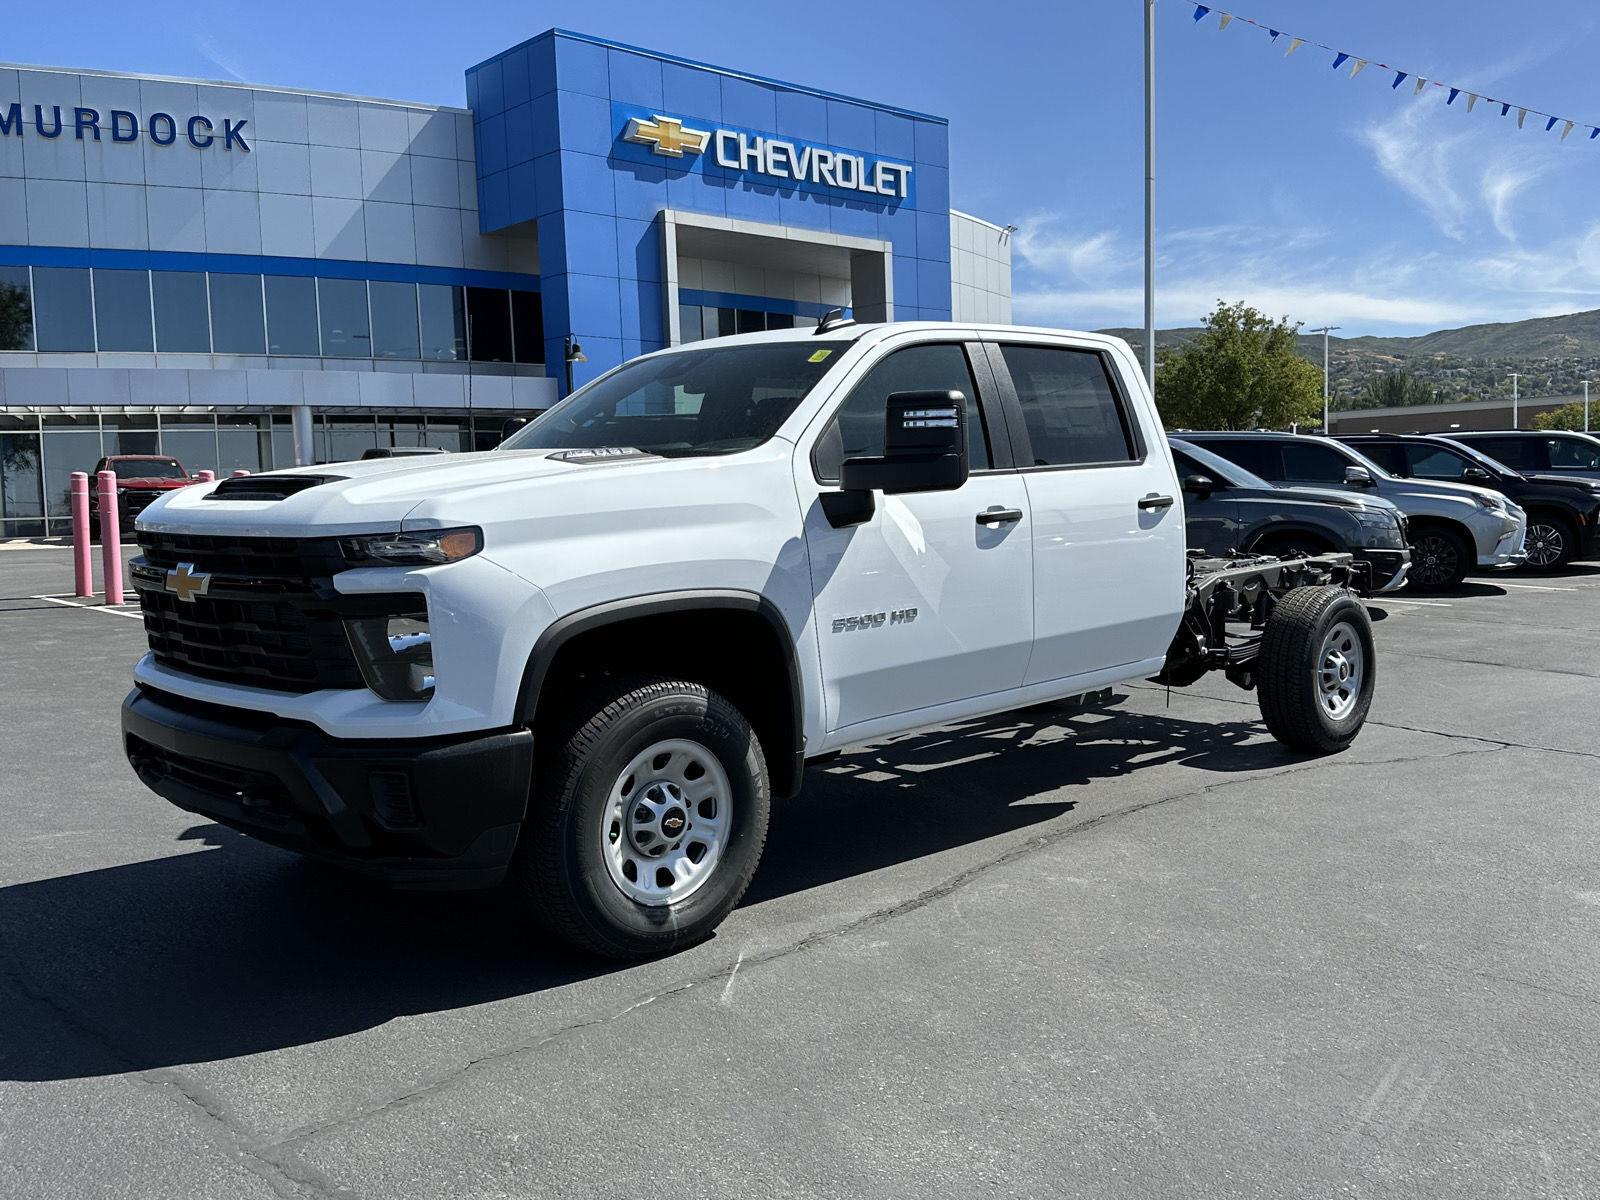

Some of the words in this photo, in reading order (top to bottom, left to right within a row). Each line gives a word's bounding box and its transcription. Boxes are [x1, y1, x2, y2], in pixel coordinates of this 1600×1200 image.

[0, 102, 251, 152] MURDOCK
[715, 129, 912, 198] CHEVROLET
[890, 607, 918, 624] HD
